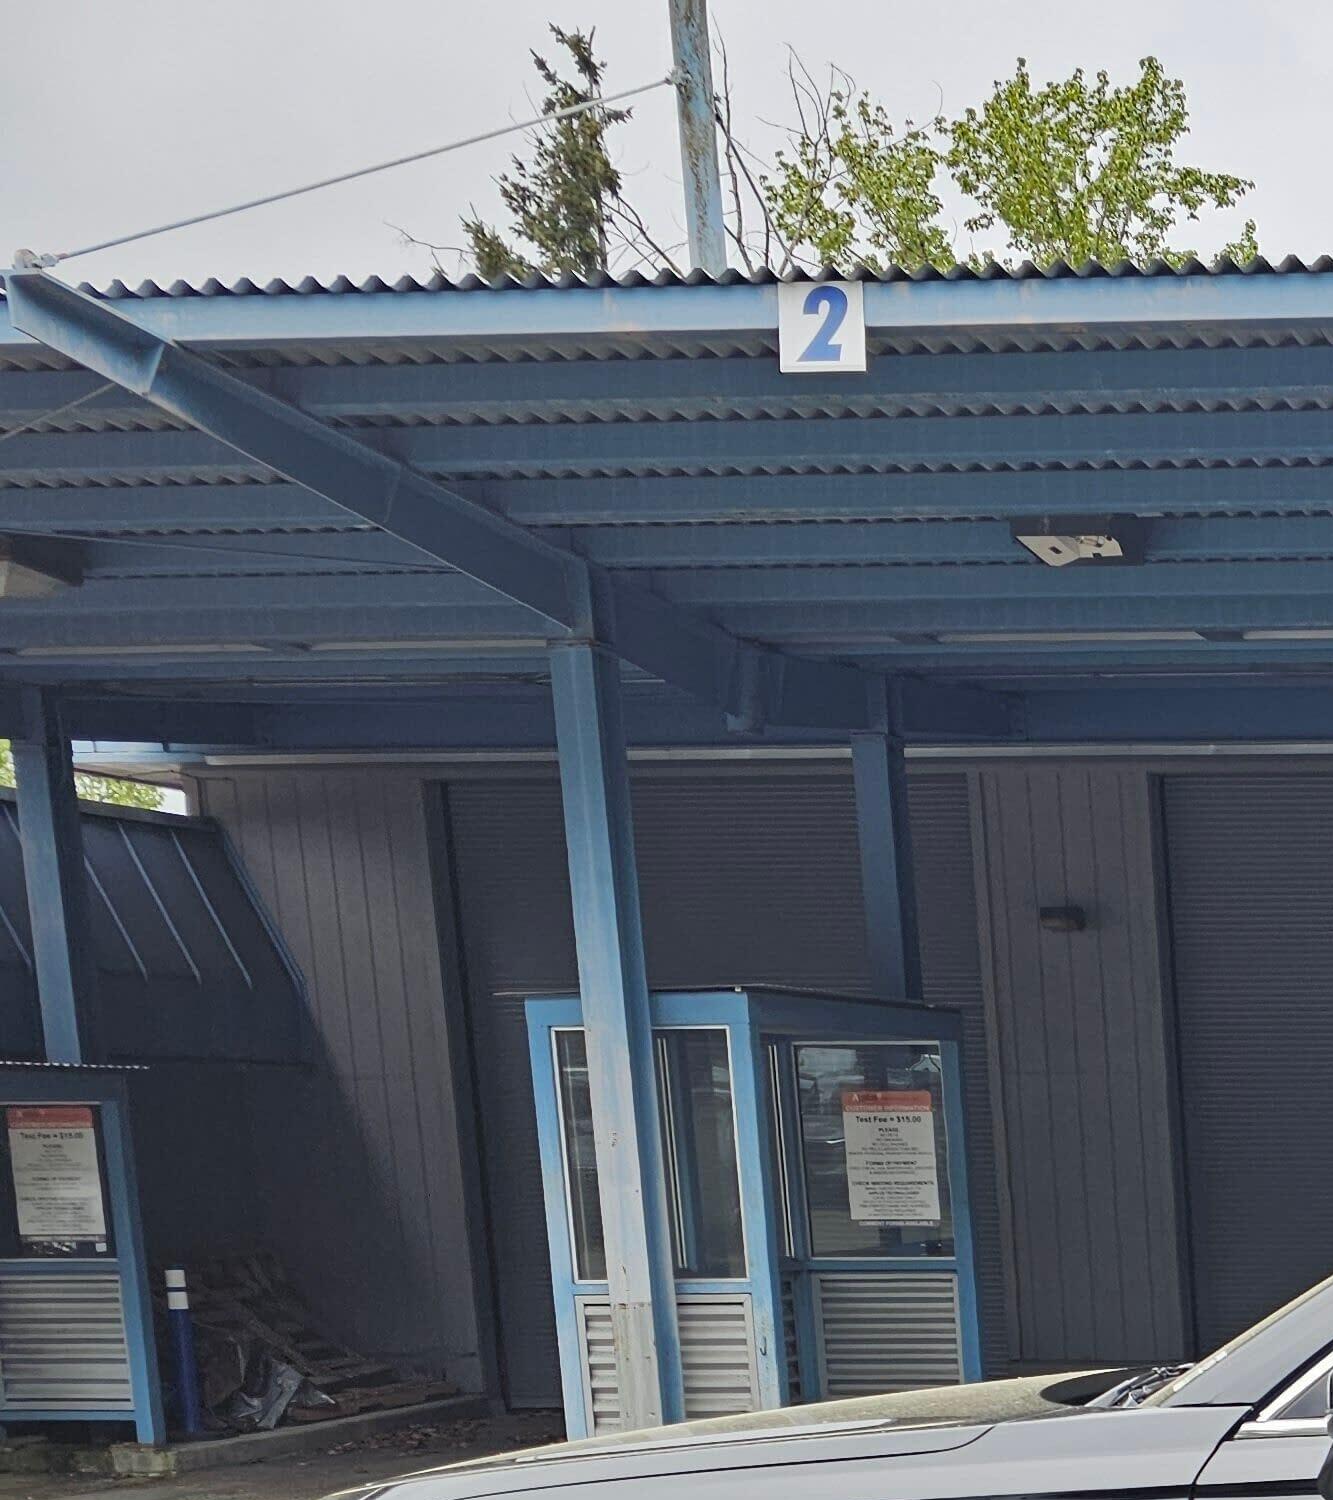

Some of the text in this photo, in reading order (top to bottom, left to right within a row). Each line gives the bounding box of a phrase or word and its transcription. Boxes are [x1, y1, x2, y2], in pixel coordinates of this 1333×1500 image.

[796, 285, 848, 362] 2
[856, 1115, 871, 1123] Test
[874, 1115, 888, 1123] Fee
[896, 1115, 922, 1123] $15.00
